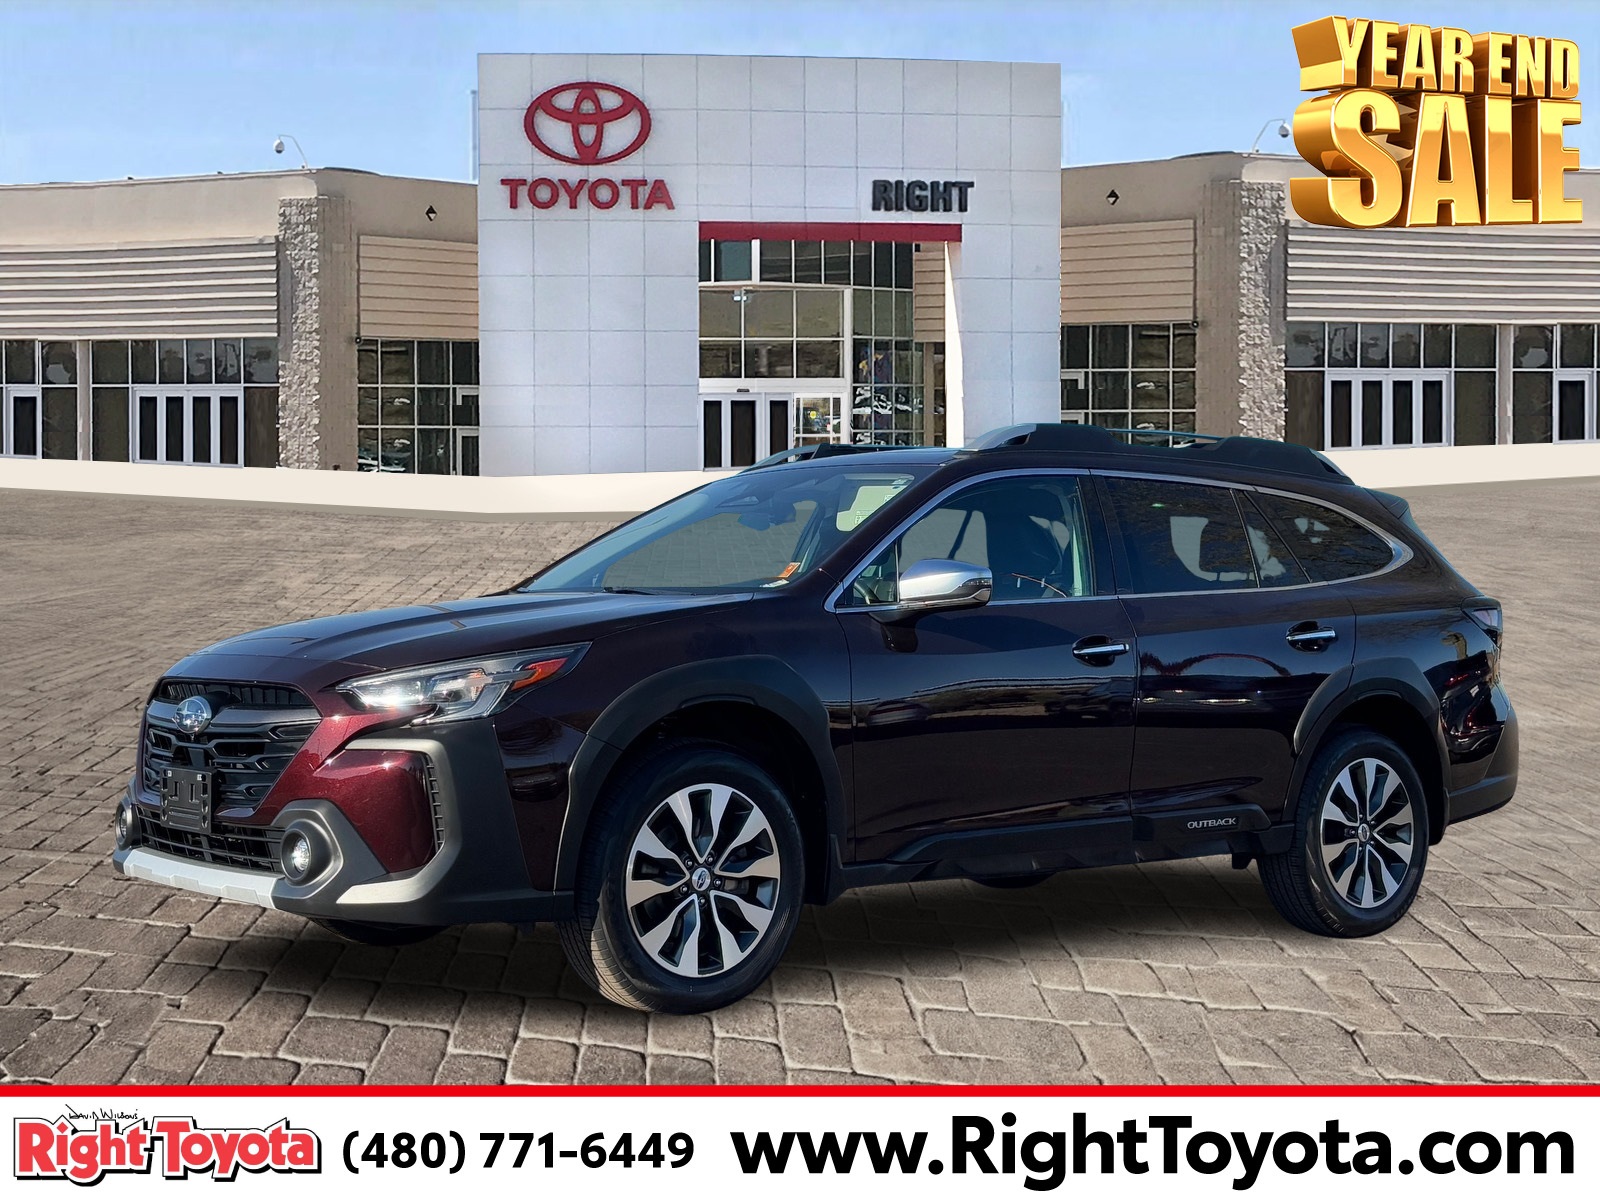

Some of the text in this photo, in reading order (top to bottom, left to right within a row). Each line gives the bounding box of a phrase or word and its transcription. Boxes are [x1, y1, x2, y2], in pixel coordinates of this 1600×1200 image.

[500, 177, 676, 210] TOYOTA
[871, 179, 975, 213] RIGHT
[1186, 817, 1237, 829] OUTBACK
